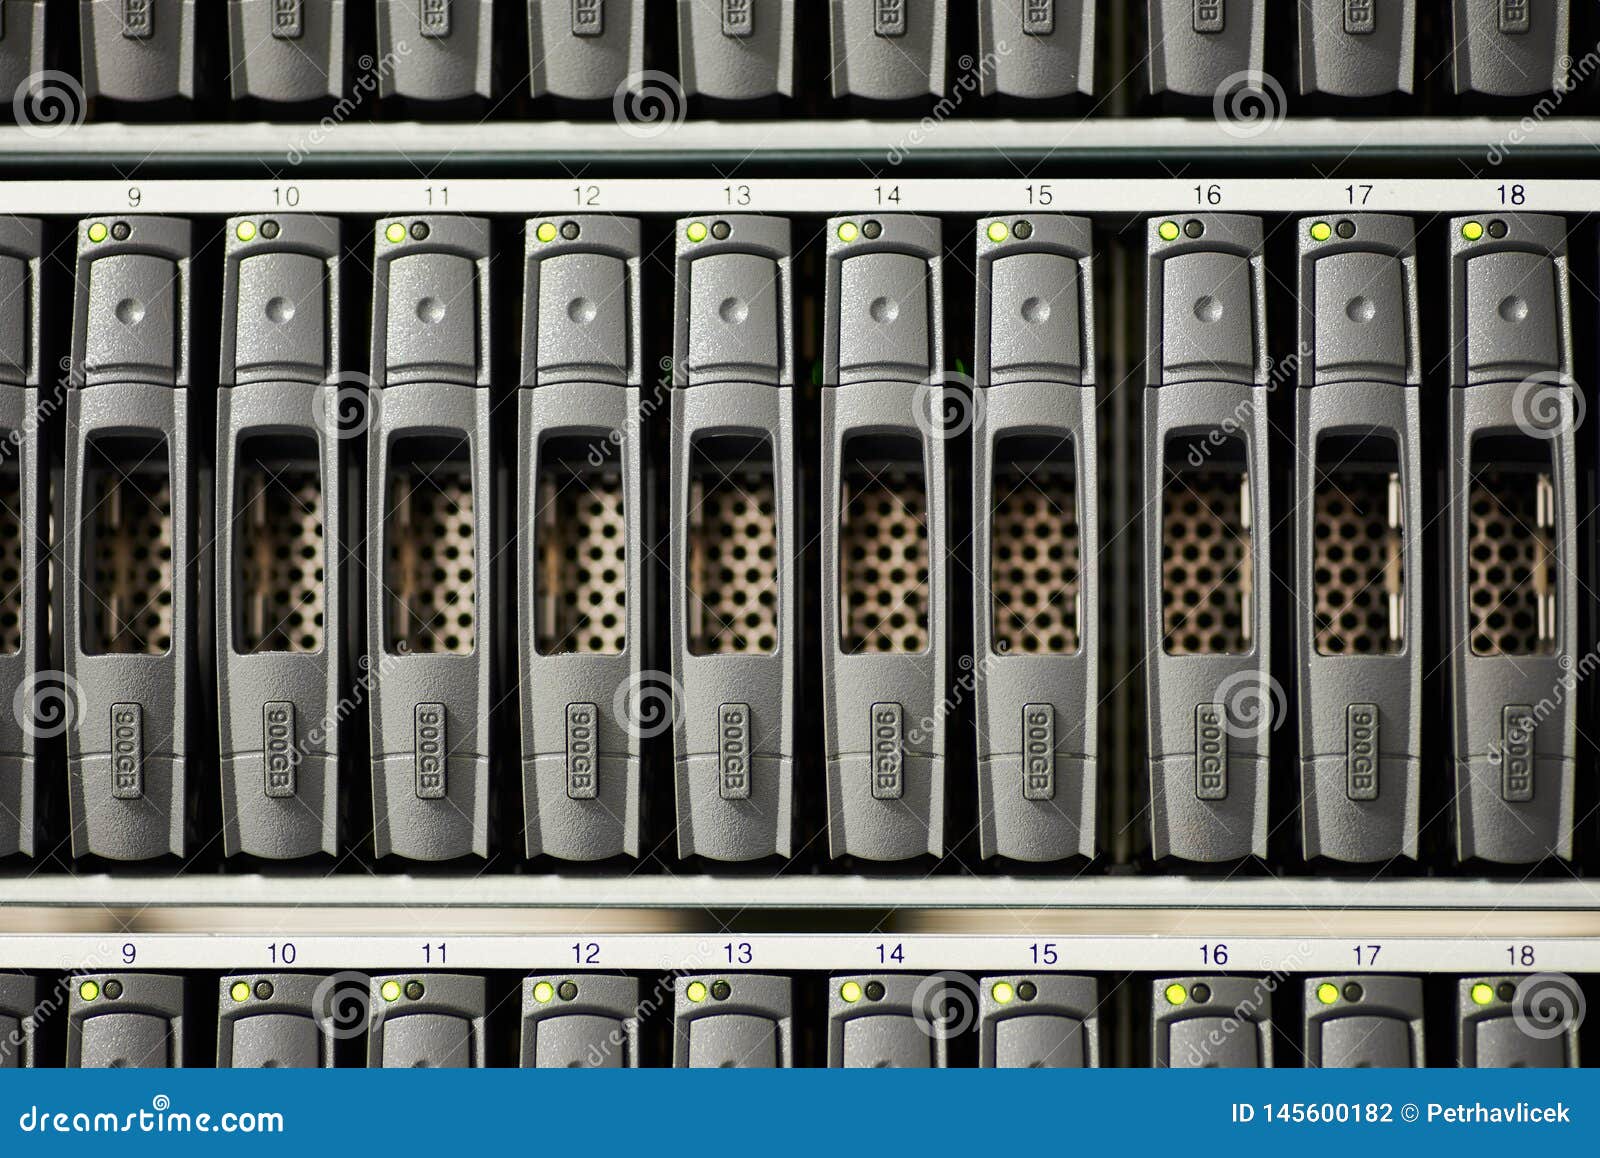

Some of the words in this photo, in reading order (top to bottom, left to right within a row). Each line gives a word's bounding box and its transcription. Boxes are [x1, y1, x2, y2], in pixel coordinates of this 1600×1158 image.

[128, 187, 141, 207] 9
[273, 186, 300, 207] 10
[424, 186, 450, 206] 11
[573, 185, 601, 206] 12
[724, 185, 752, 206] 13
[874, 185, 902, 206] 14
[1025, 184, 1053, 206] 15
[1194, 184, 1222, 206] 16
[1345, 184, 1374, 206] 17
[1497, 183, 1526, 206] 18
[116, 710, 137, 790] 900GB
[268, 709, 290, 789] 900GB
[419, 710, 440, 790] 900GB
[572, 710, 592, 790] 900GB
[724, 710, 745, 790] 900GB
[876, 710, 897, 790] 900GB
[1028, 711, 1049, 791] 900GB
[1201, 711, 1222, 791] 900GB
[1352, 711, 1374, 791] 900GB
[122, 942, 137, 965] 9
[267, 942, 297, 965] 10
[421, 942, 448, 965] 11
[571, 942, 601, 965] 12
[723, 942, 753, 965] 13
[875, 942, 906, 965] 14
[1028, 943, 1058, 966] 15
[1199, 943, 1229, 966] 16
[1352, 944, 1382, 967] 17
[1506, 944, 1536, 968] 18
